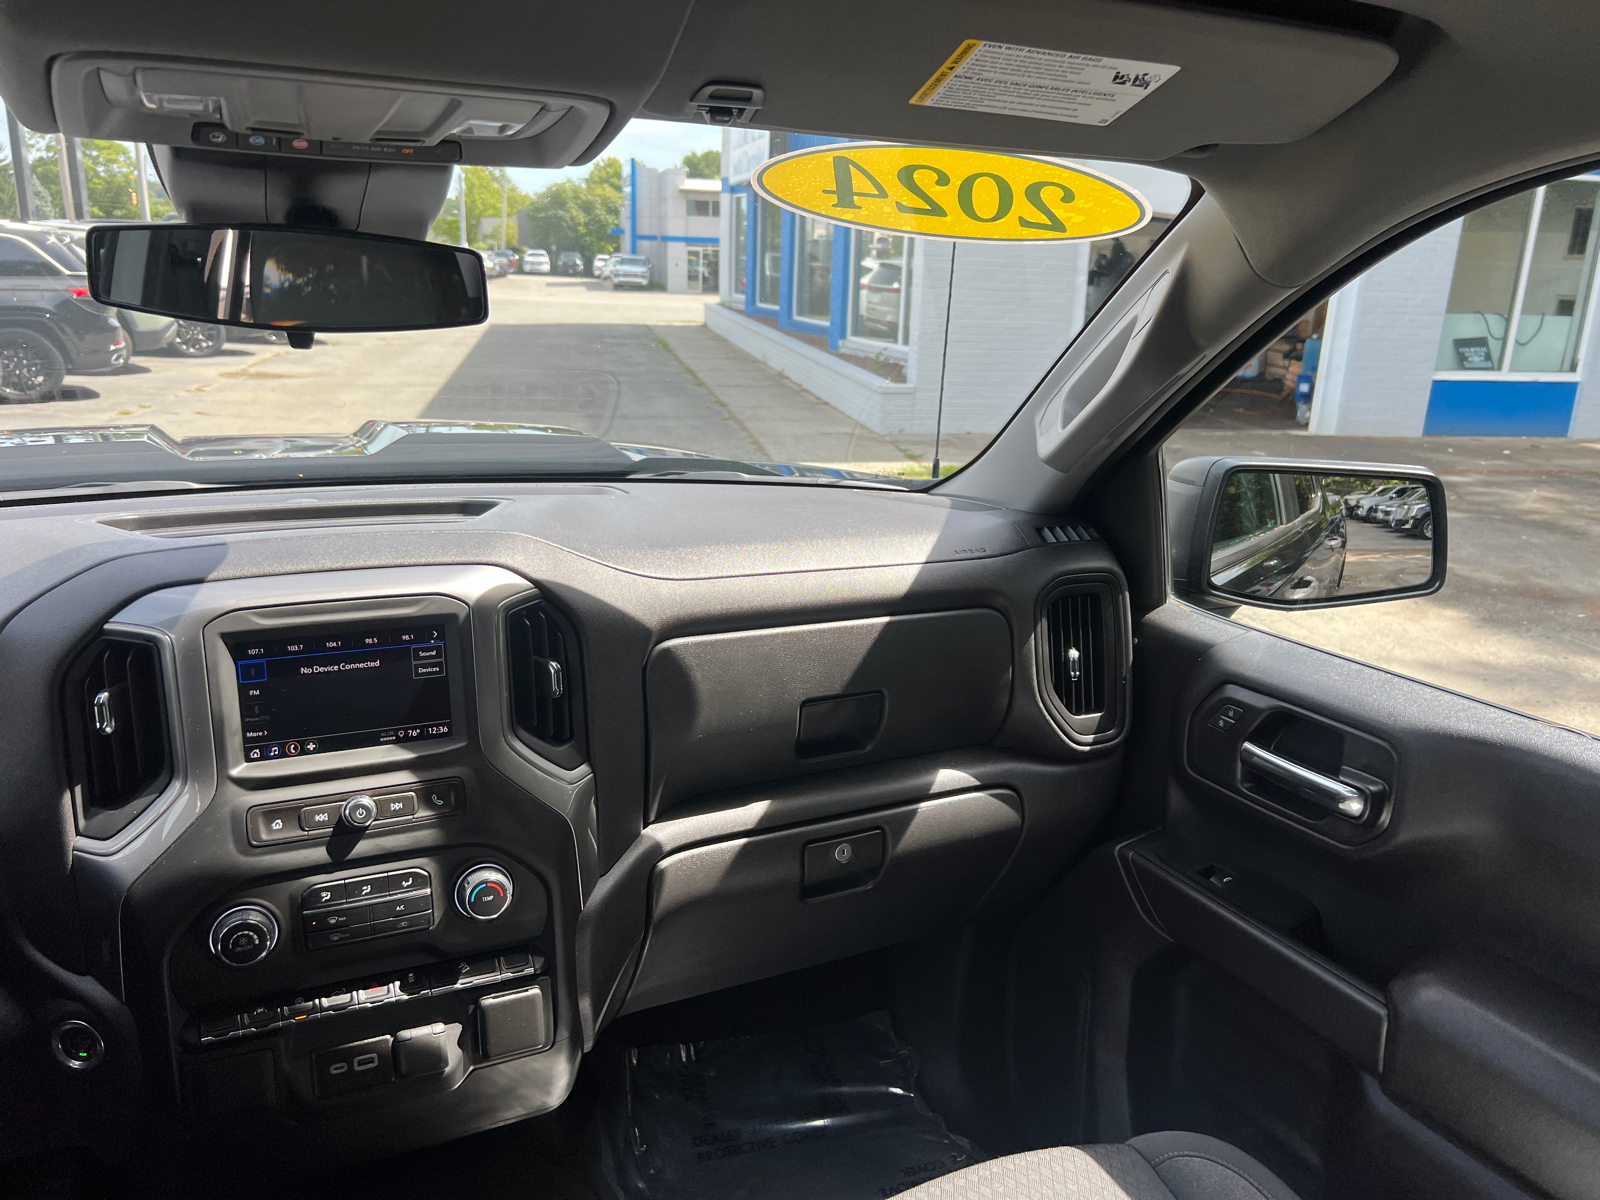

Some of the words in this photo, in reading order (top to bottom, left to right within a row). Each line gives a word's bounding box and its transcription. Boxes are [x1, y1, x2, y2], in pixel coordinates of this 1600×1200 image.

[1004, 45, 1025, 53] WITH
[1025, 48, 1067, 58] ADVANCED
[954, 547, 987, 555] AIRBAG
[248, 648, 265, 656] 107.1
[287, 644, 304, 652] 103.7
[418, 649, 437, 657] Sound
[300, 667, 313, 675] No
[313, 664, 339, 673] Device
[339, 659, 380, 670] Connected
[418, 666, 440, 674] Devices
[428, 725, 449, 734] 12:36
[482, 894, 494, 902] TEMP
